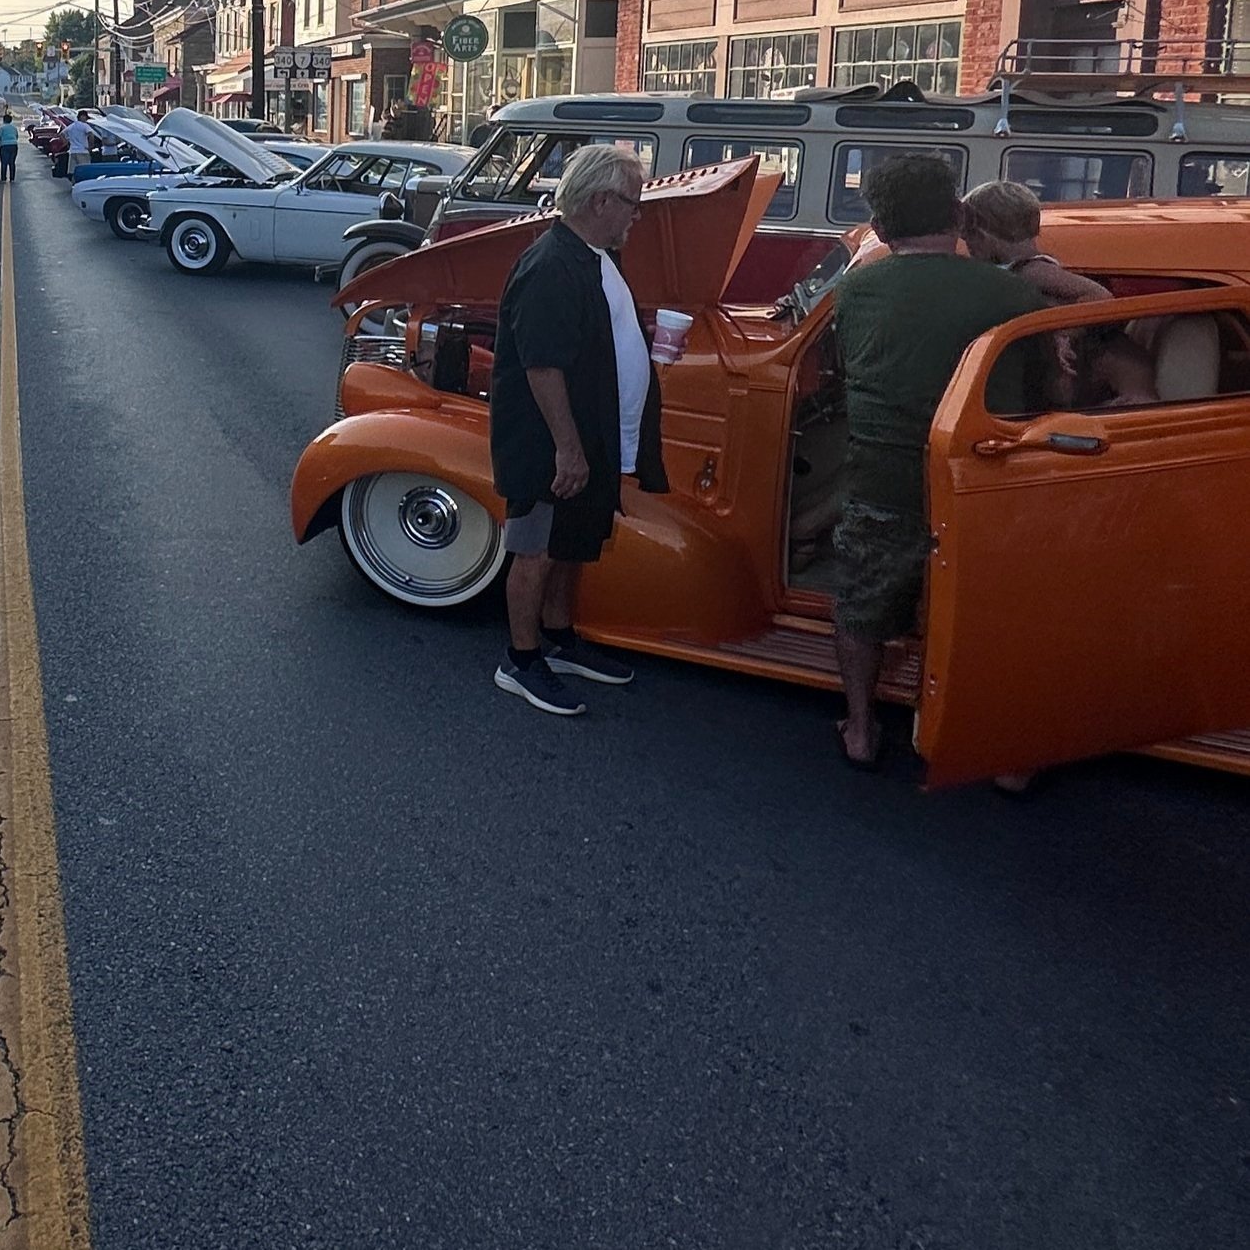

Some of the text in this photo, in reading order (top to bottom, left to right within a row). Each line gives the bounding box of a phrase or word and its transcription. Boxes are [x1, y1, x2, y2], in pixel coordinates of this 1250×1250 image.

[453, 43, 479, 52] ARTS
[275, 56, 291, 66] 340
[313, 56, 330, 66] 340
[416, 62, 436, 106] OPEN
